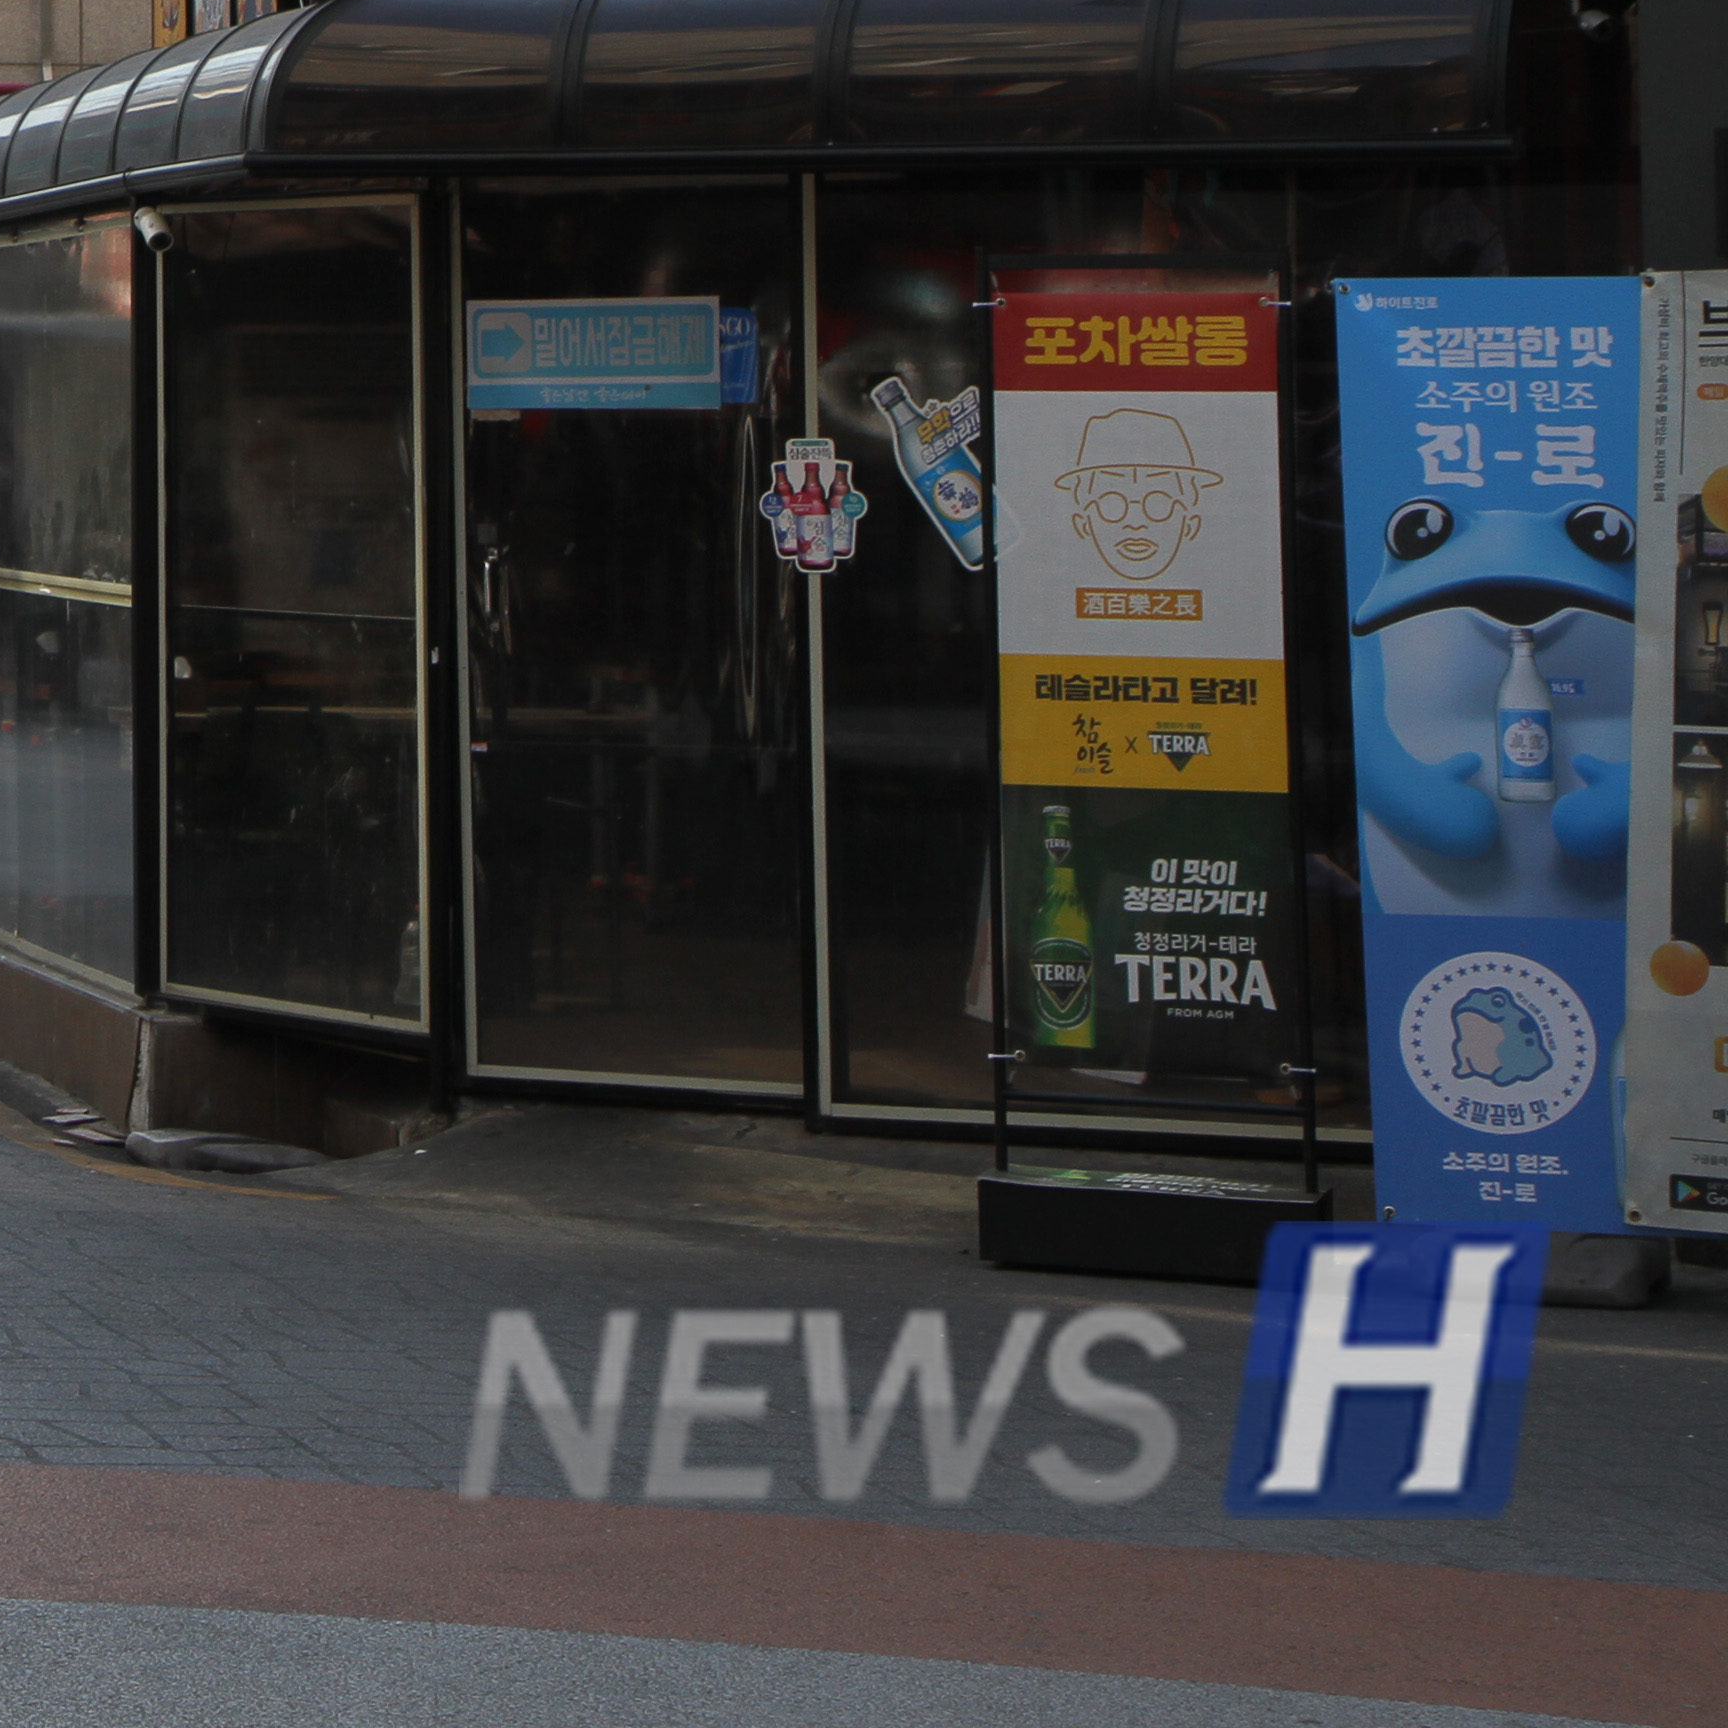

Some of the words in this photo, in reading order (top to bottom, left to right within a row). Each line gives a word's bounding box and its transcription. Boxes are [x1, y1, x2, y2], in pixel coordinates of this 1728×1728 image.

[1375, 296, 1438, 310] 하이트진로
[534, 314, 707, 369] 밀어서잠금해제
[1024, 315, 1248, 366] 포차쌀롱
[1396, 326, 1561, 368] 초깔끔한
[1570, 326, 1614, 368] 맛
[1416, 380, 1518, 413] 소주의
[1526, 380, 1600, 413] 원조
[1416, 422, 1605, 488] 진-로
[1036, 674, 1179, 703] 테슬라타고
[1190, 678, 1258, 705] 달려!
[1148, 733, 1212, 757] TERRA
[1151, 858, 1178, 883] 이
[1182, 859, 1238, 886] 맛이
[1123, 886, 1268, 917] 청정라거다!
[1134, 932, 1257, 955] 청정라거-테라
[1035, 963, 1088, 983] TERRA
[1115, 954, 1278, 1011] TERRA
[1167, 1007, 1203, 1018] FROM
[1206, 1009, 1234, 1020] AGM
[1453, 1096, 1527, 1127] 초깔끔한
[1529, 1098, 1552, 1123] 맛
[1443, 1151, 1510, 1173] 소주의
[1479, 1180, 1538, 1203] 진-로
